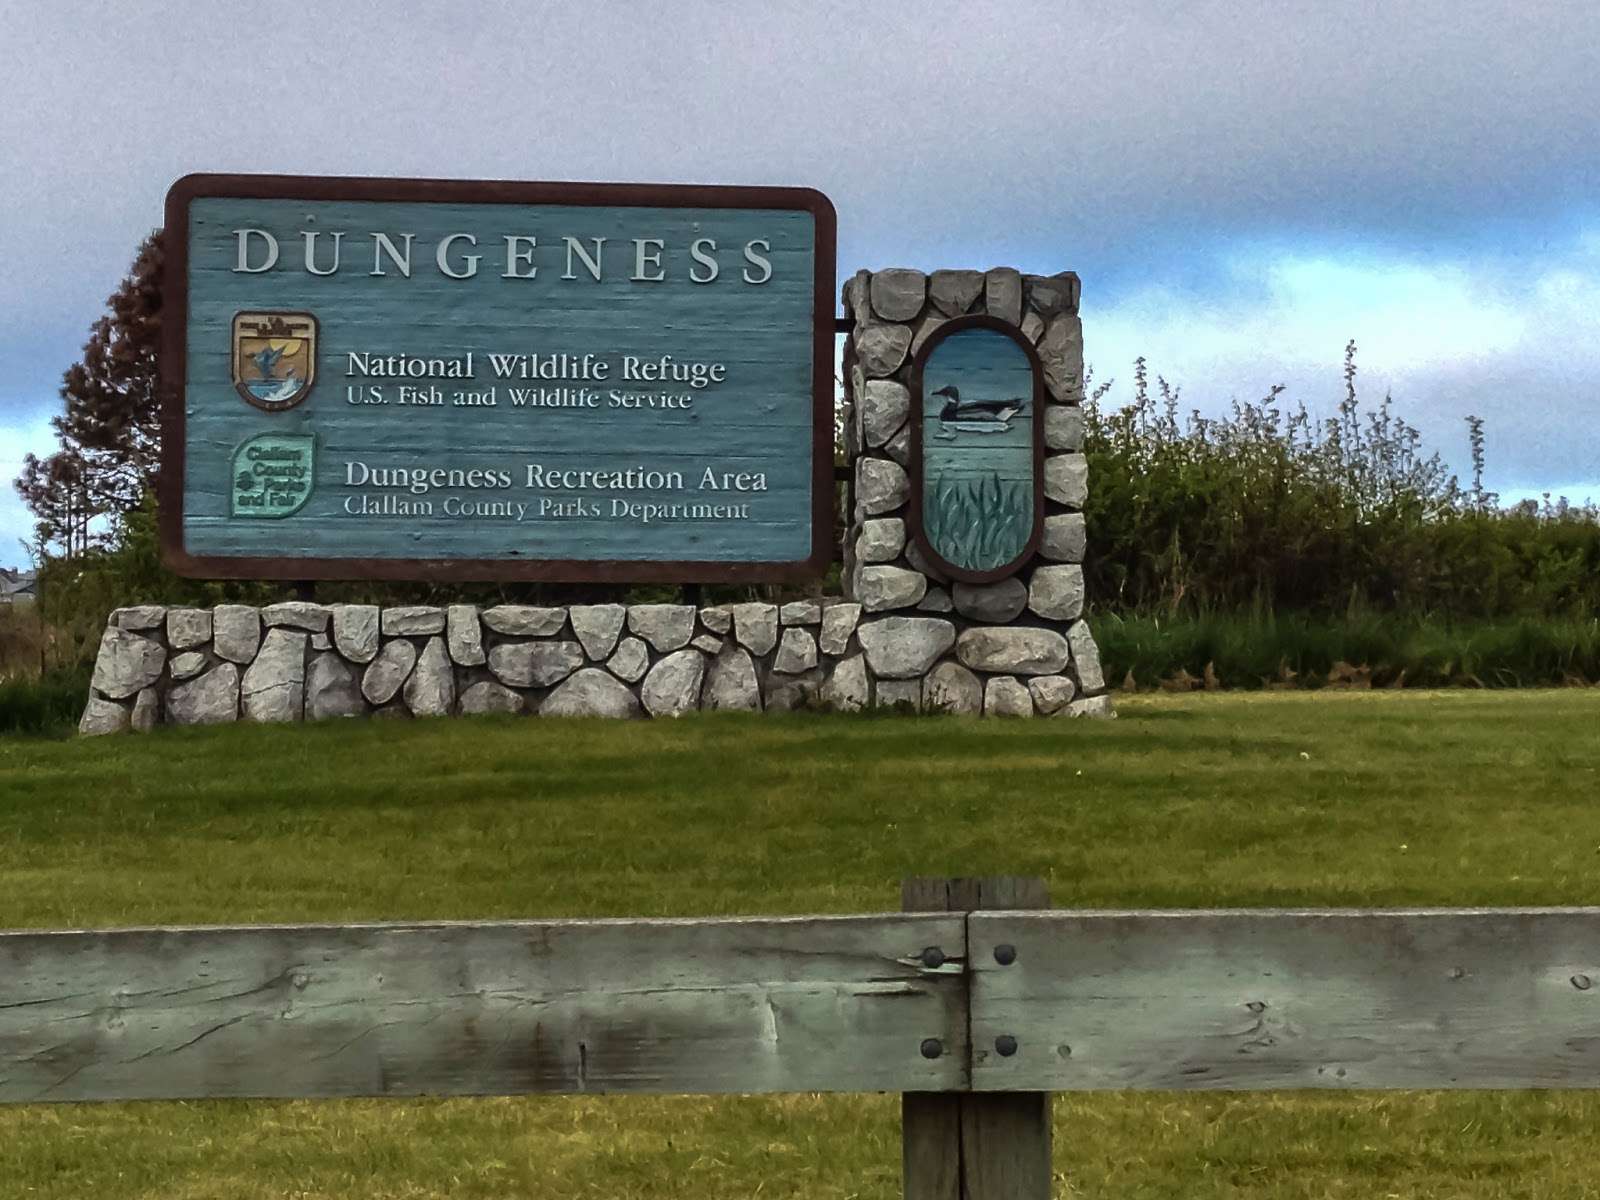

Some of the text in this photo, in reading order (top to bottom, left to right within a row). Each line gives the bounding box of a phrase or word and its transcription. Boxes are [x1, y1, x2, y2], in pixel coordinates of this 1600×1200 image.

[232, 228, 774, 286] DUNGENESS
[345, 351, 727, 389] National Wildlife Refuge
[346, 385, 693, 409] U.S. Fish and Wildlife Service
[253, 462, 307, 479] County
[344, 461, 768, 494] Dungeness Recreation Area
[238, 493, 265, 507] and
[344, 495, 750, 523] Clallam County Parks Department
